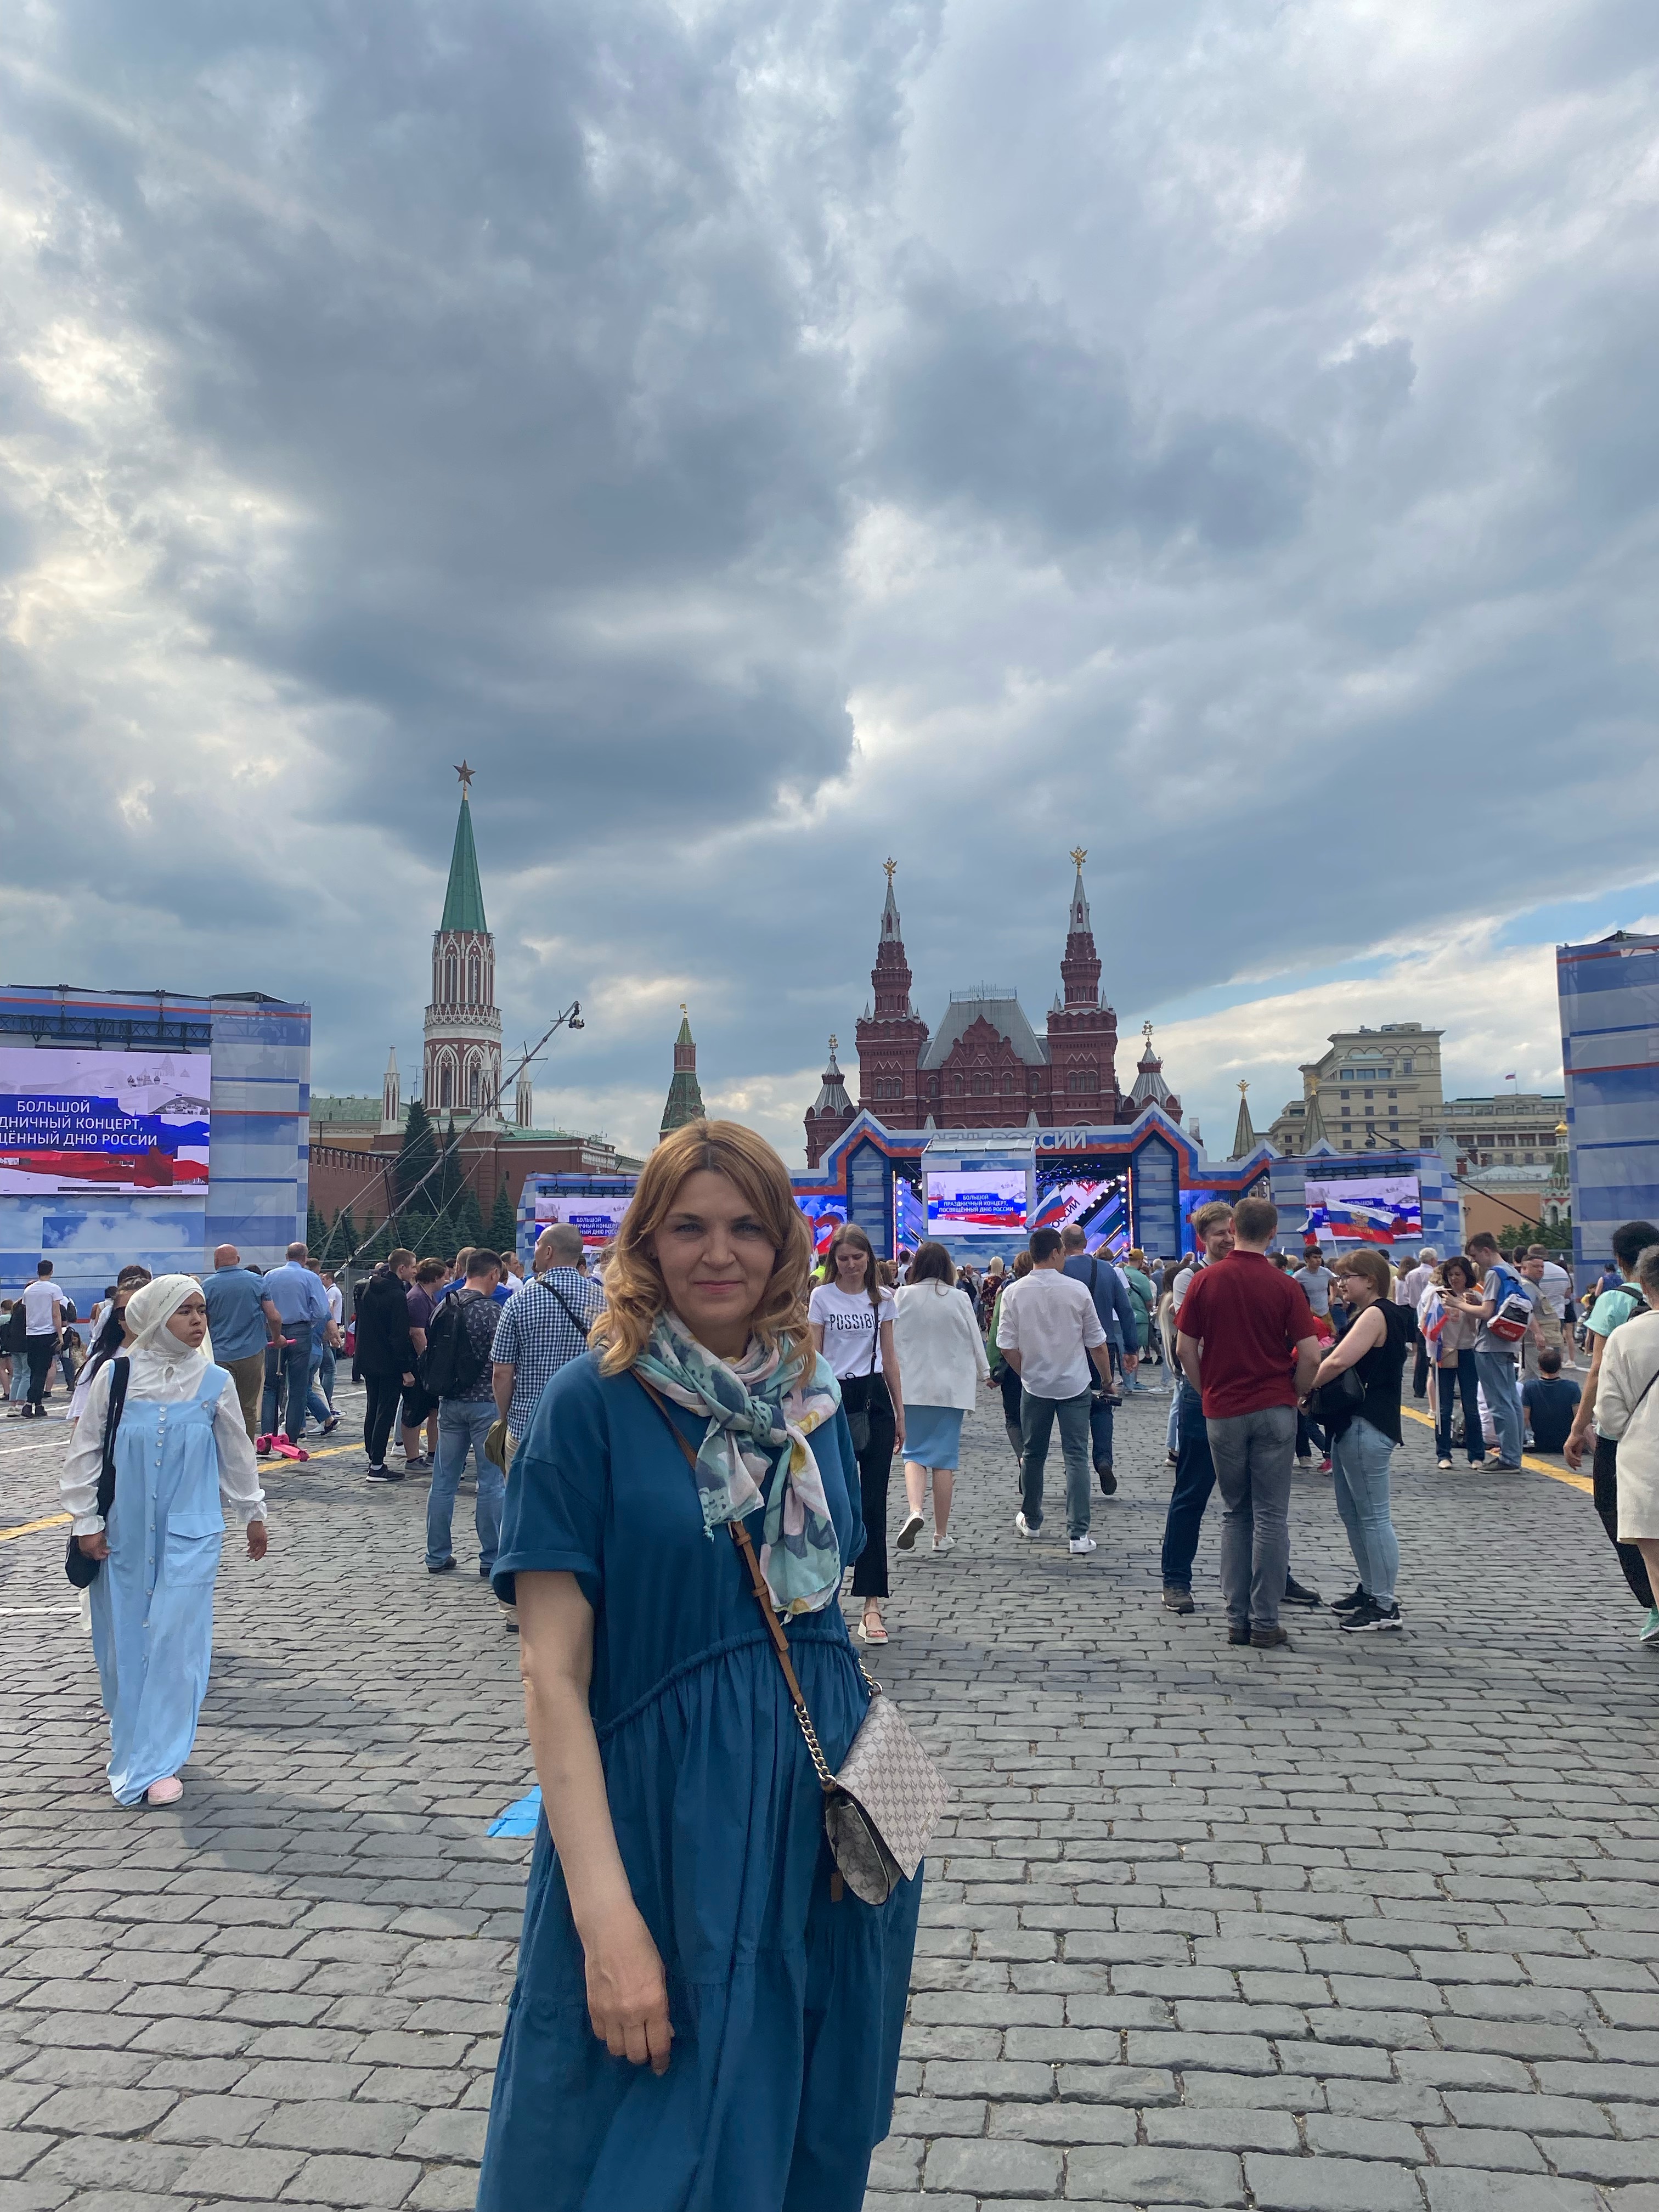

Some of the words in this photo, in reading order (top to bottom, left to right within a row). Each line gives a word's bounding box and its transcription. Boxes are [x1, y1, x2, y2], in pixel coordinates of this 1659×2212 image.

[17, 1099, 90, 1114] БОЛЬШОЙ
[0, 1115, 71, 1129] ДНИЧНЫЙ
[76, 1117, 143, 1132] КОНЦЕРТ,
[63, 1133, 98, 1147] ДНЮ
[102, 1134, 157, 1146] РОССИИ
